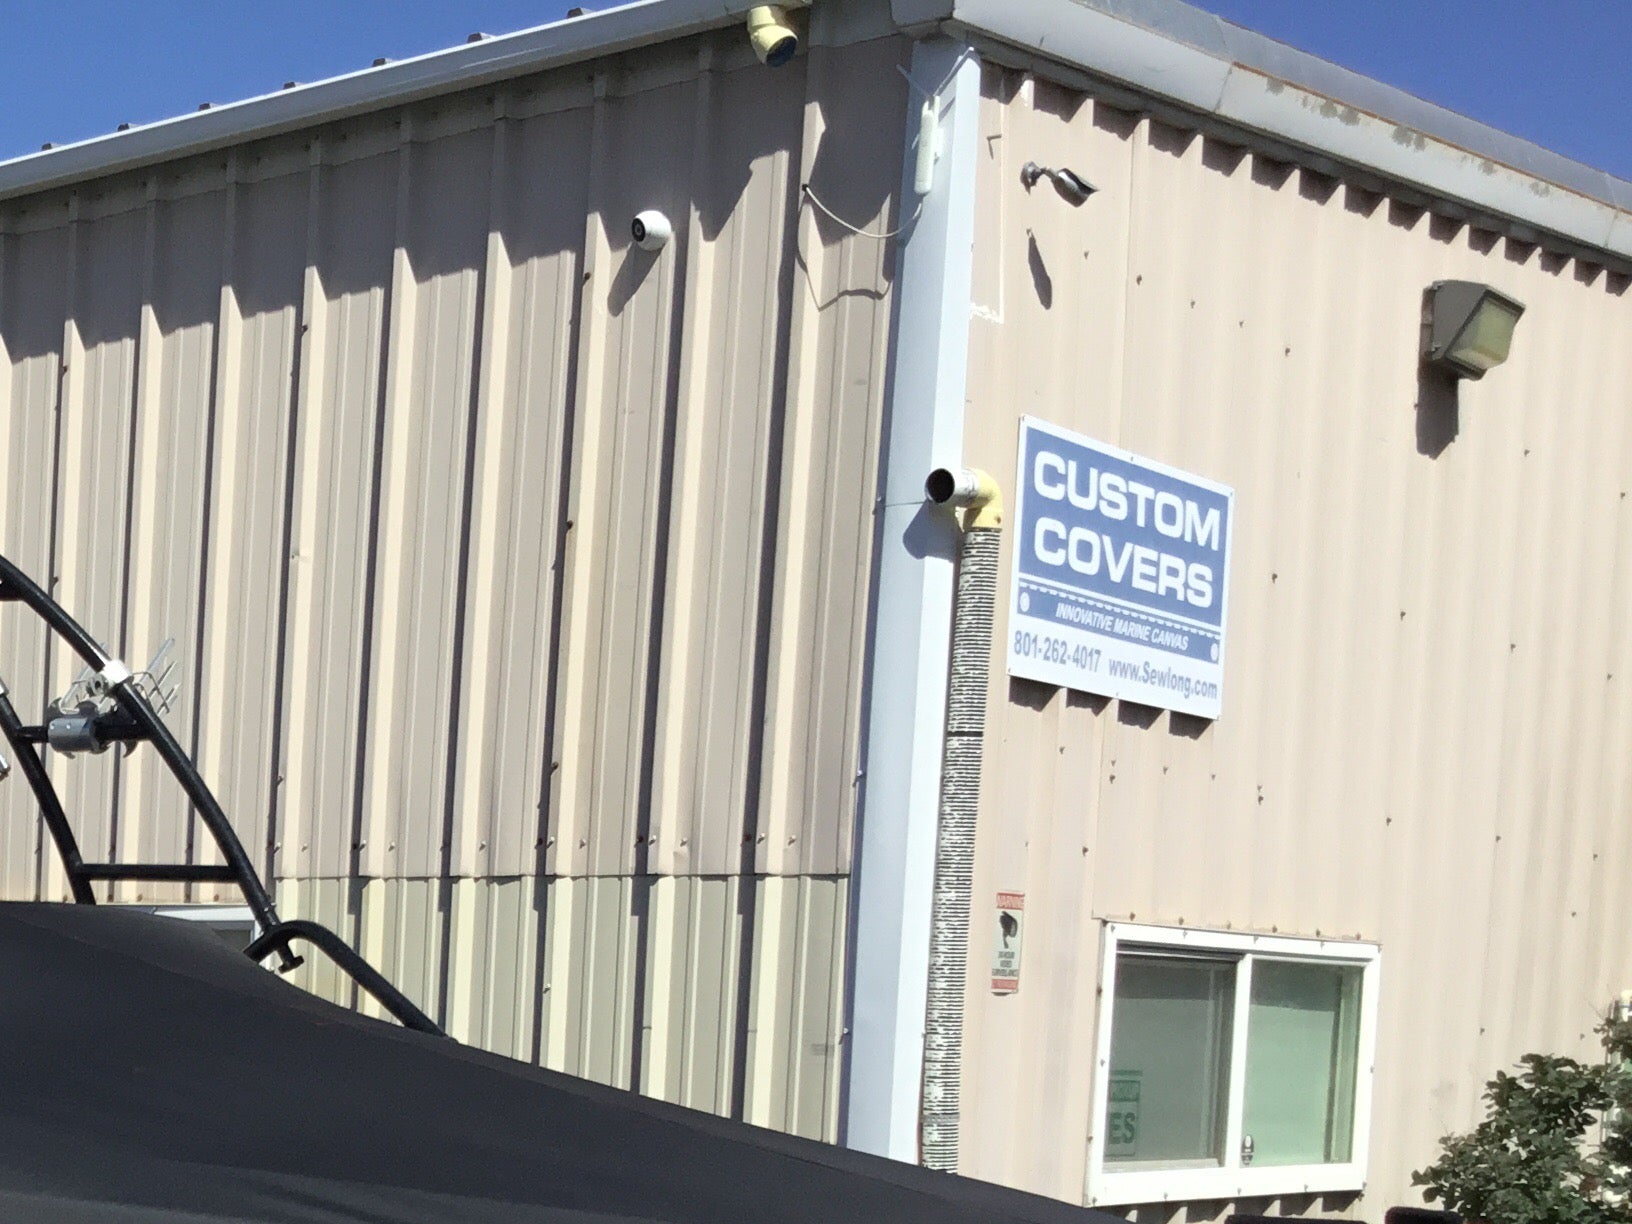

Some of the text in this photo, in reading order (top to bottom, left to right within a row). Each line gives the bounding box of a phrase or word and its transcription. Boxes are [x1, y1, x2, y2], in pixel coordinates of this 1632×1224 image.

[1033, 450, 1221, 551] CUSTOM
[1033, 516, 1214, 608] COVERS
[1013, 630, 1218, 700] 801-262-4017 www.Sewlong.com
[1055, 602, 1189, 651] INNOVATIVE MARINE CANVAS
